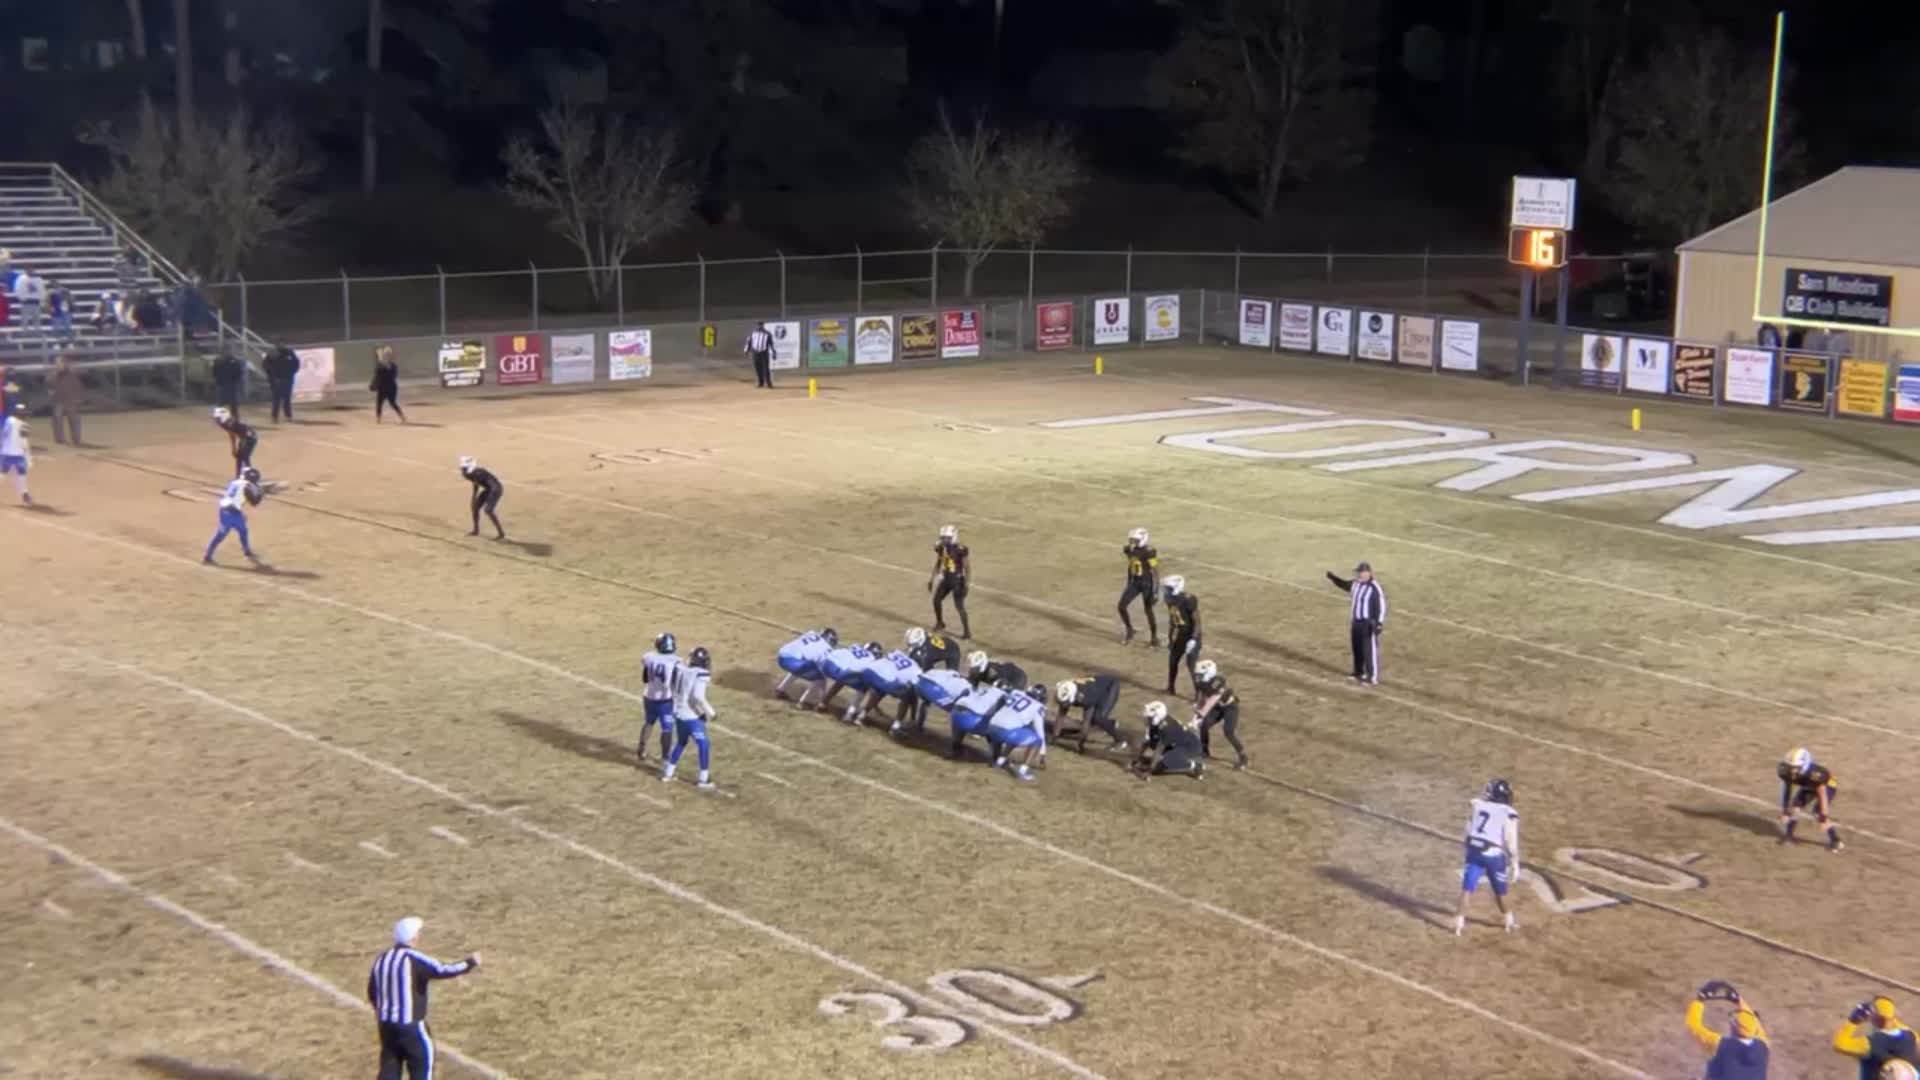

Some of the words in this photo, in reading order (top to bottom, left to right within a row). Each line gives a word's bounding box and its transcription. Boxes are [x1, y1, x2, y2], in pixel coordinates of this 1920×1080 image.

[1529, 230, 1555, 266] 16
[1786, 295, 1804, 313] QB
[1807, 298, 1835, 315] Club
[1838, 301, 1889, 324] Building
[500, 353, 539, 373] GBT
[1478, 810, 1490, 834] 7
[818, 966, 1082, 1051] 30
